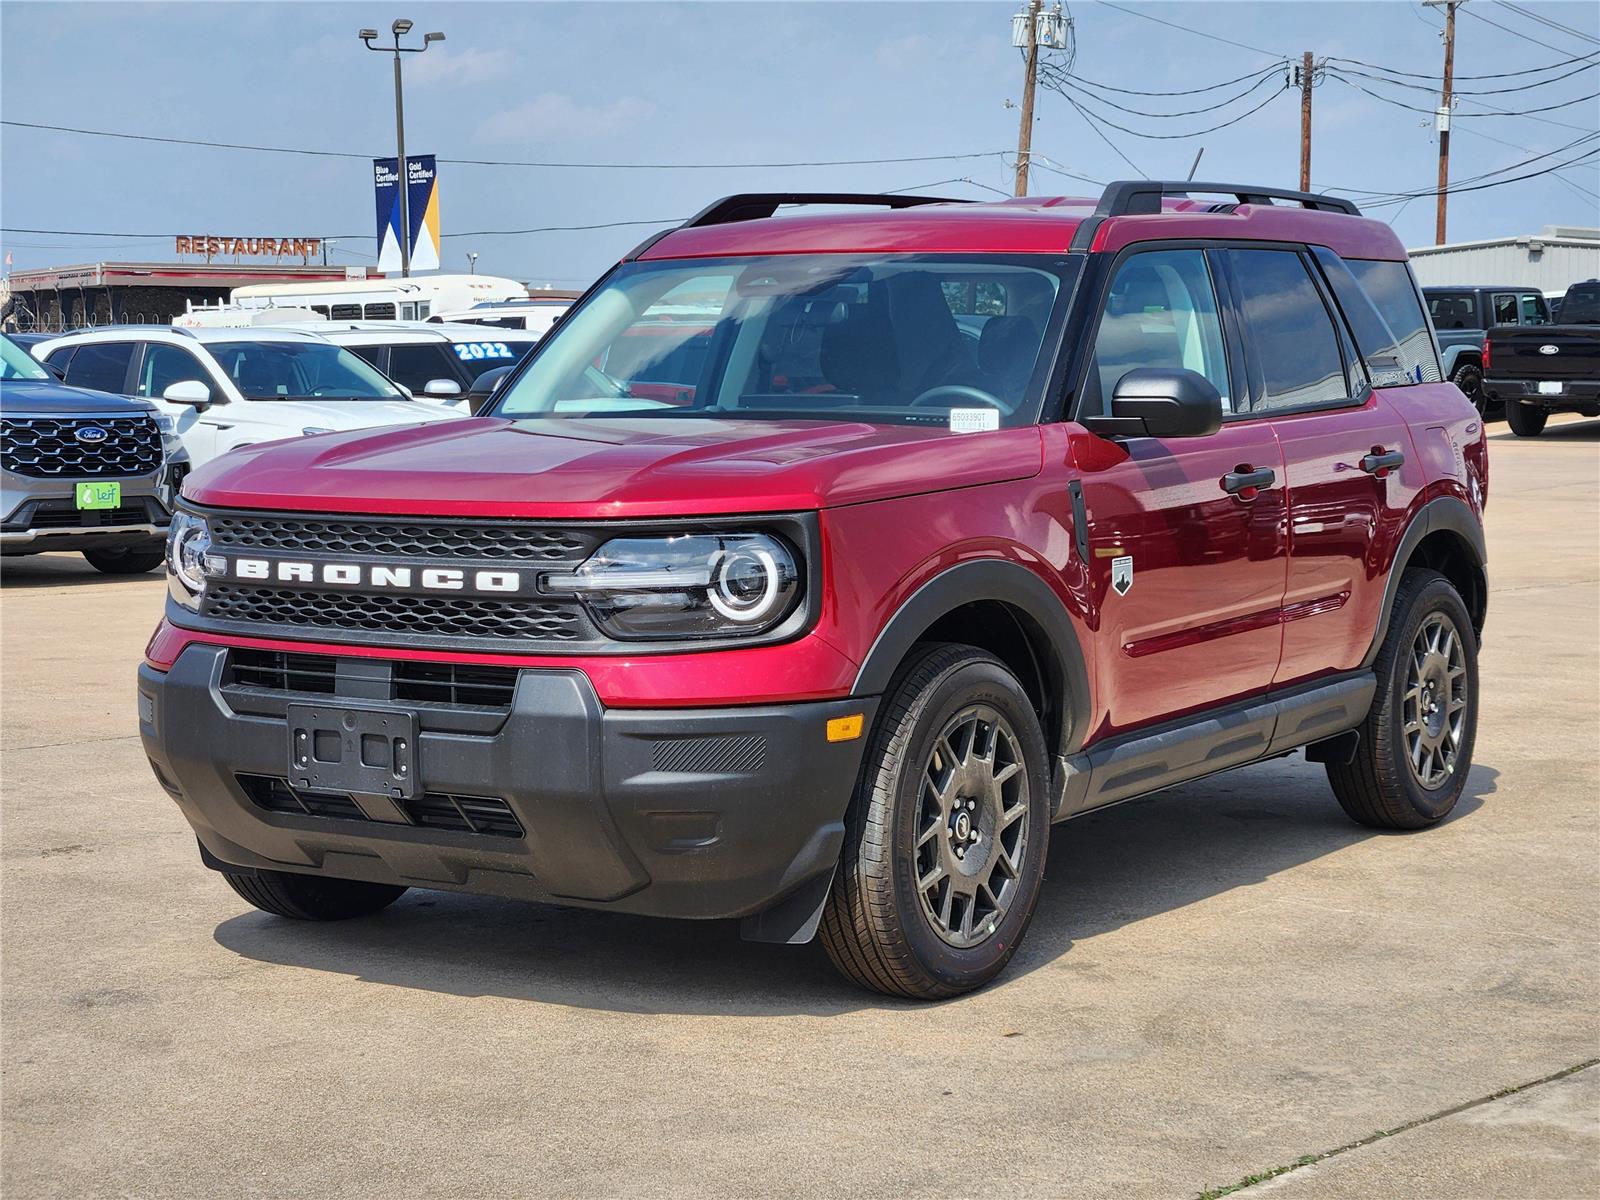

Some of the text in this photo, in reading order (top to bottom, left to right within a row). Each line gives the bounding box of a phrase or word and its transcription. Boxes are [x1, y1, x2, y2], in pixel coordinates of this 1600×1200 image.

[408, 162, 422, 170] Gold
[376, 173, 398, 182] Certified
[409, 170, 432, 178] Certified
[176, 235, 321, 257] RESTAURANT
[454, 342, 514, 361] 2022
[83, 429, 102, 439] Ford
[236, 559, 520, 592] BRONCO
